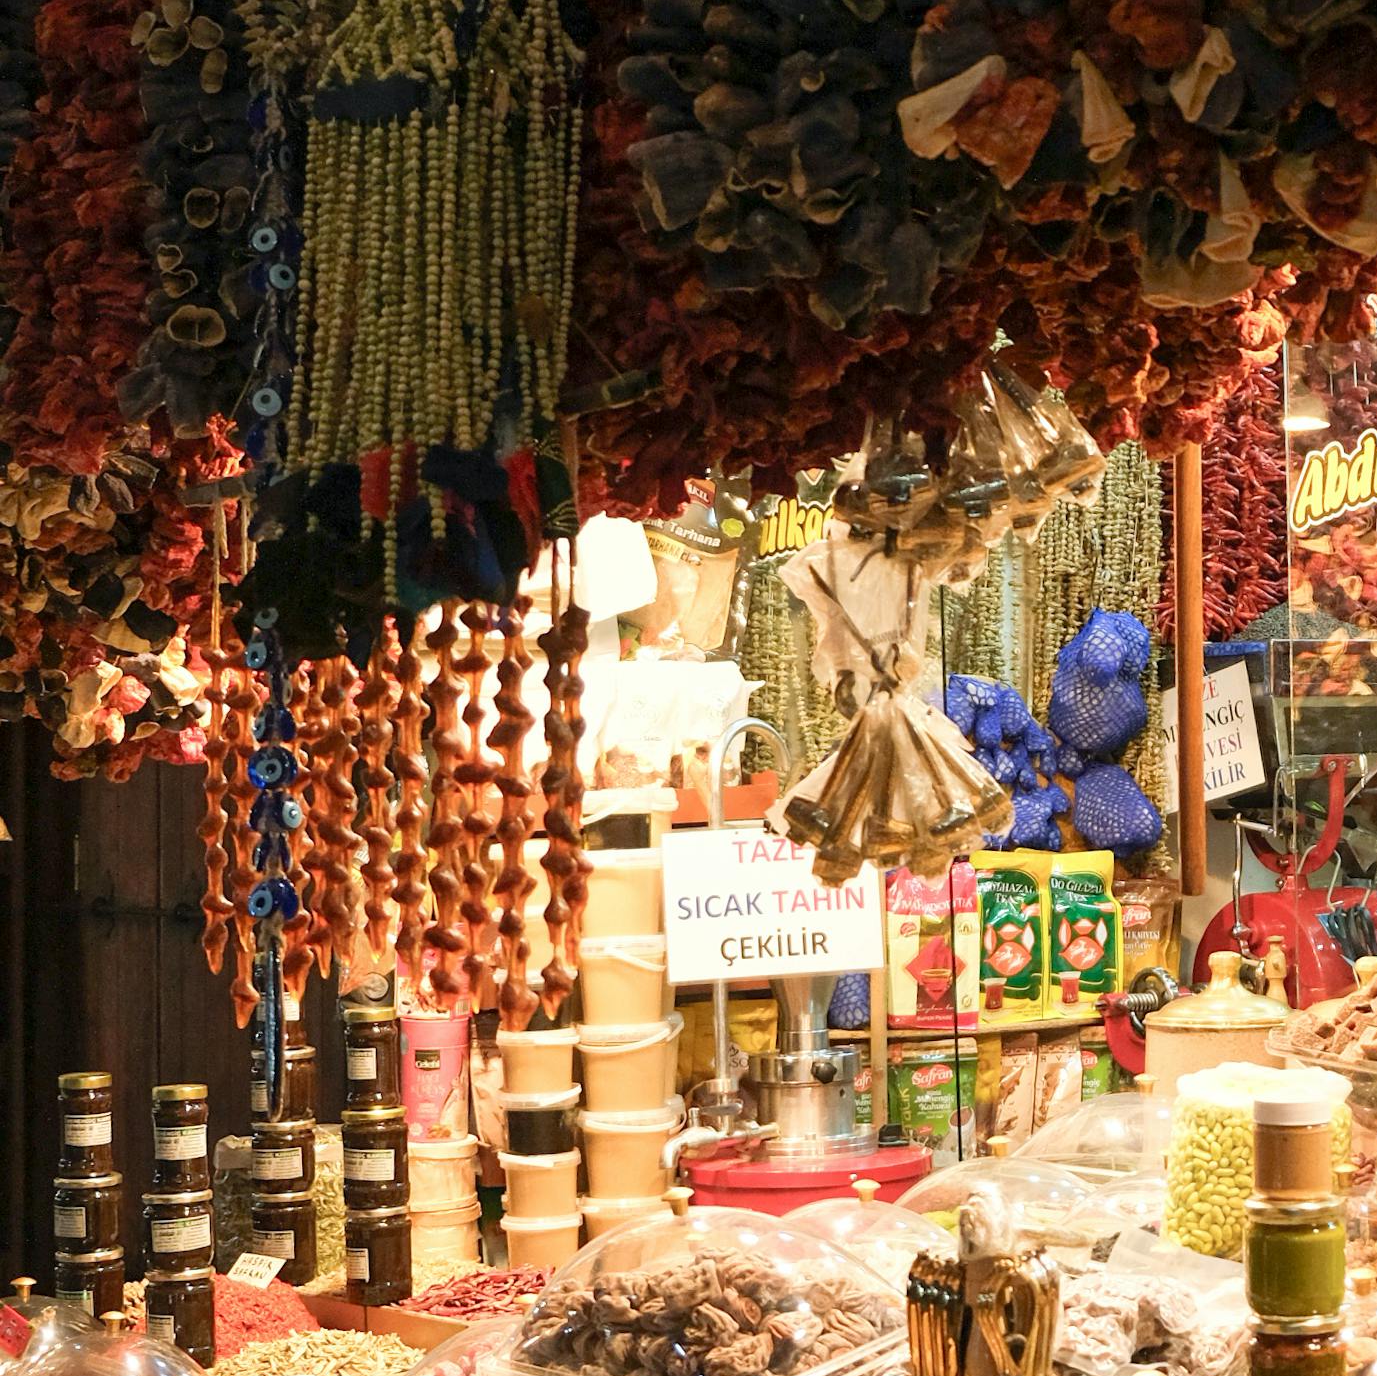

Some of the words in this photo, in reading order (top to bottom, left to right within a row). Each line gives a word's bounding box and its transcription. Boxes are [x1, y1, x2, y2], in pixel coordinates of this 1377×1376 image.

[732, 838, 805, 864] TAZE
[677, 891, 763, 920] SICAK
[720, 927, 829, 966] ÇEKİLİR
[912, 1067, 953, 1086] Safran
